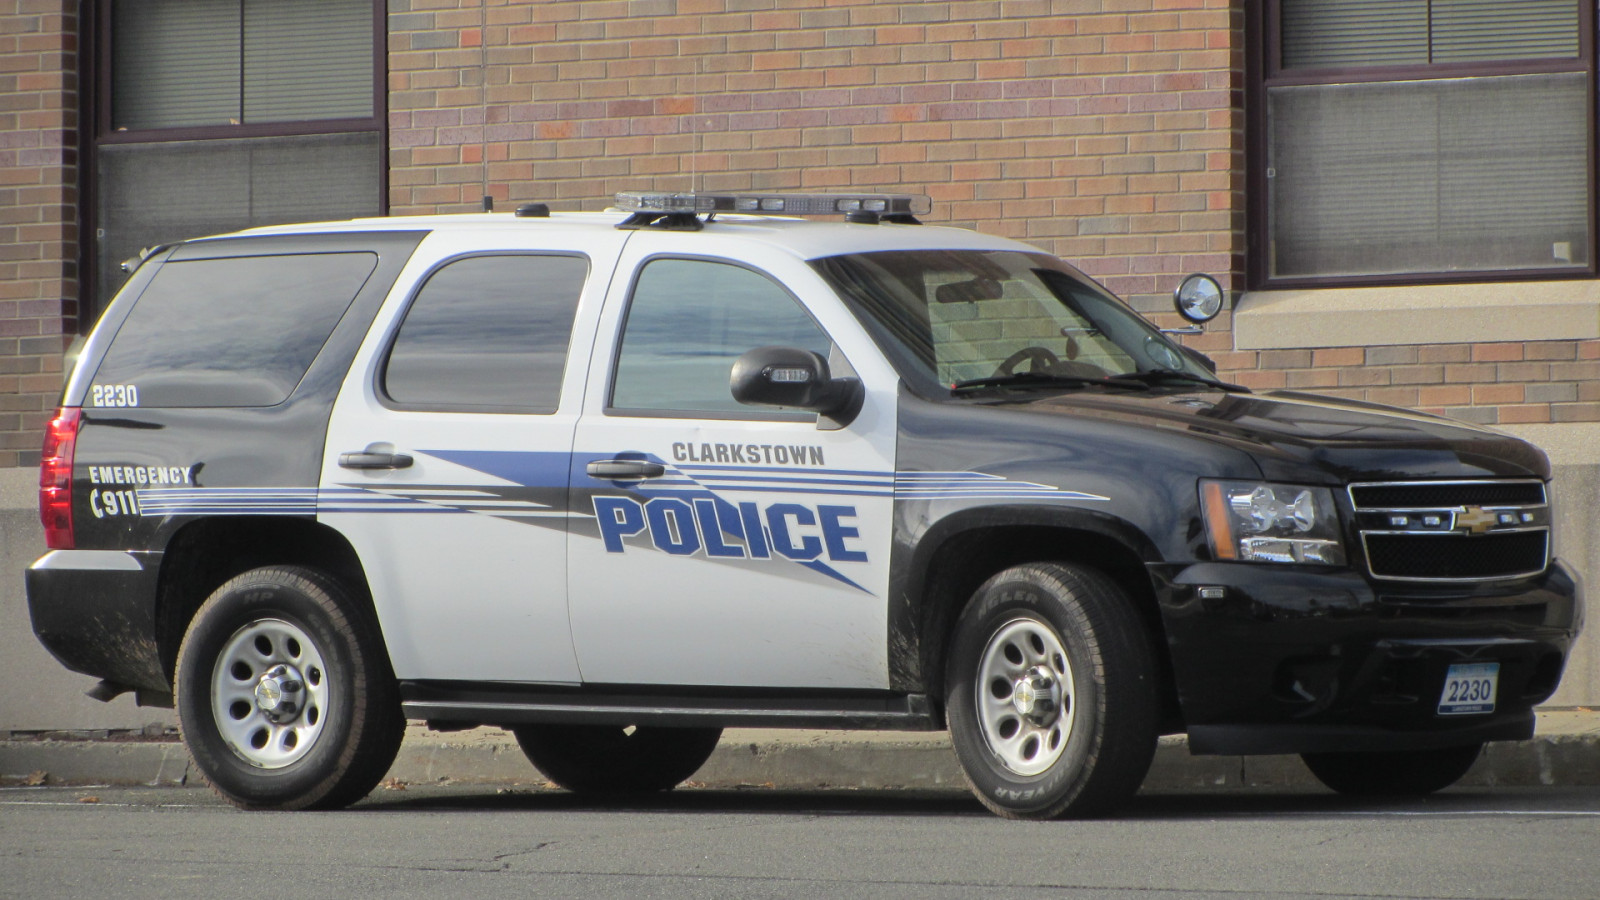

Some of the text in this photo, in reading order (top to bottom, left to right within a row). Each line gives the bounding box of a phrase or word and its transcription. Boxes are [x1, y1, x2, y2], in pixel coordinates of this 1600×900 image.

[92, 385, 138, 407] 2230
[672, 442, 824, 465] CLARKSTOWN
[88, 466, 191, 484] EMERGENCY
[102, 490, 137, 515] 911
[591, 495, 869, 562] POLICE
[1447, 679, 1491, 702] 2230
